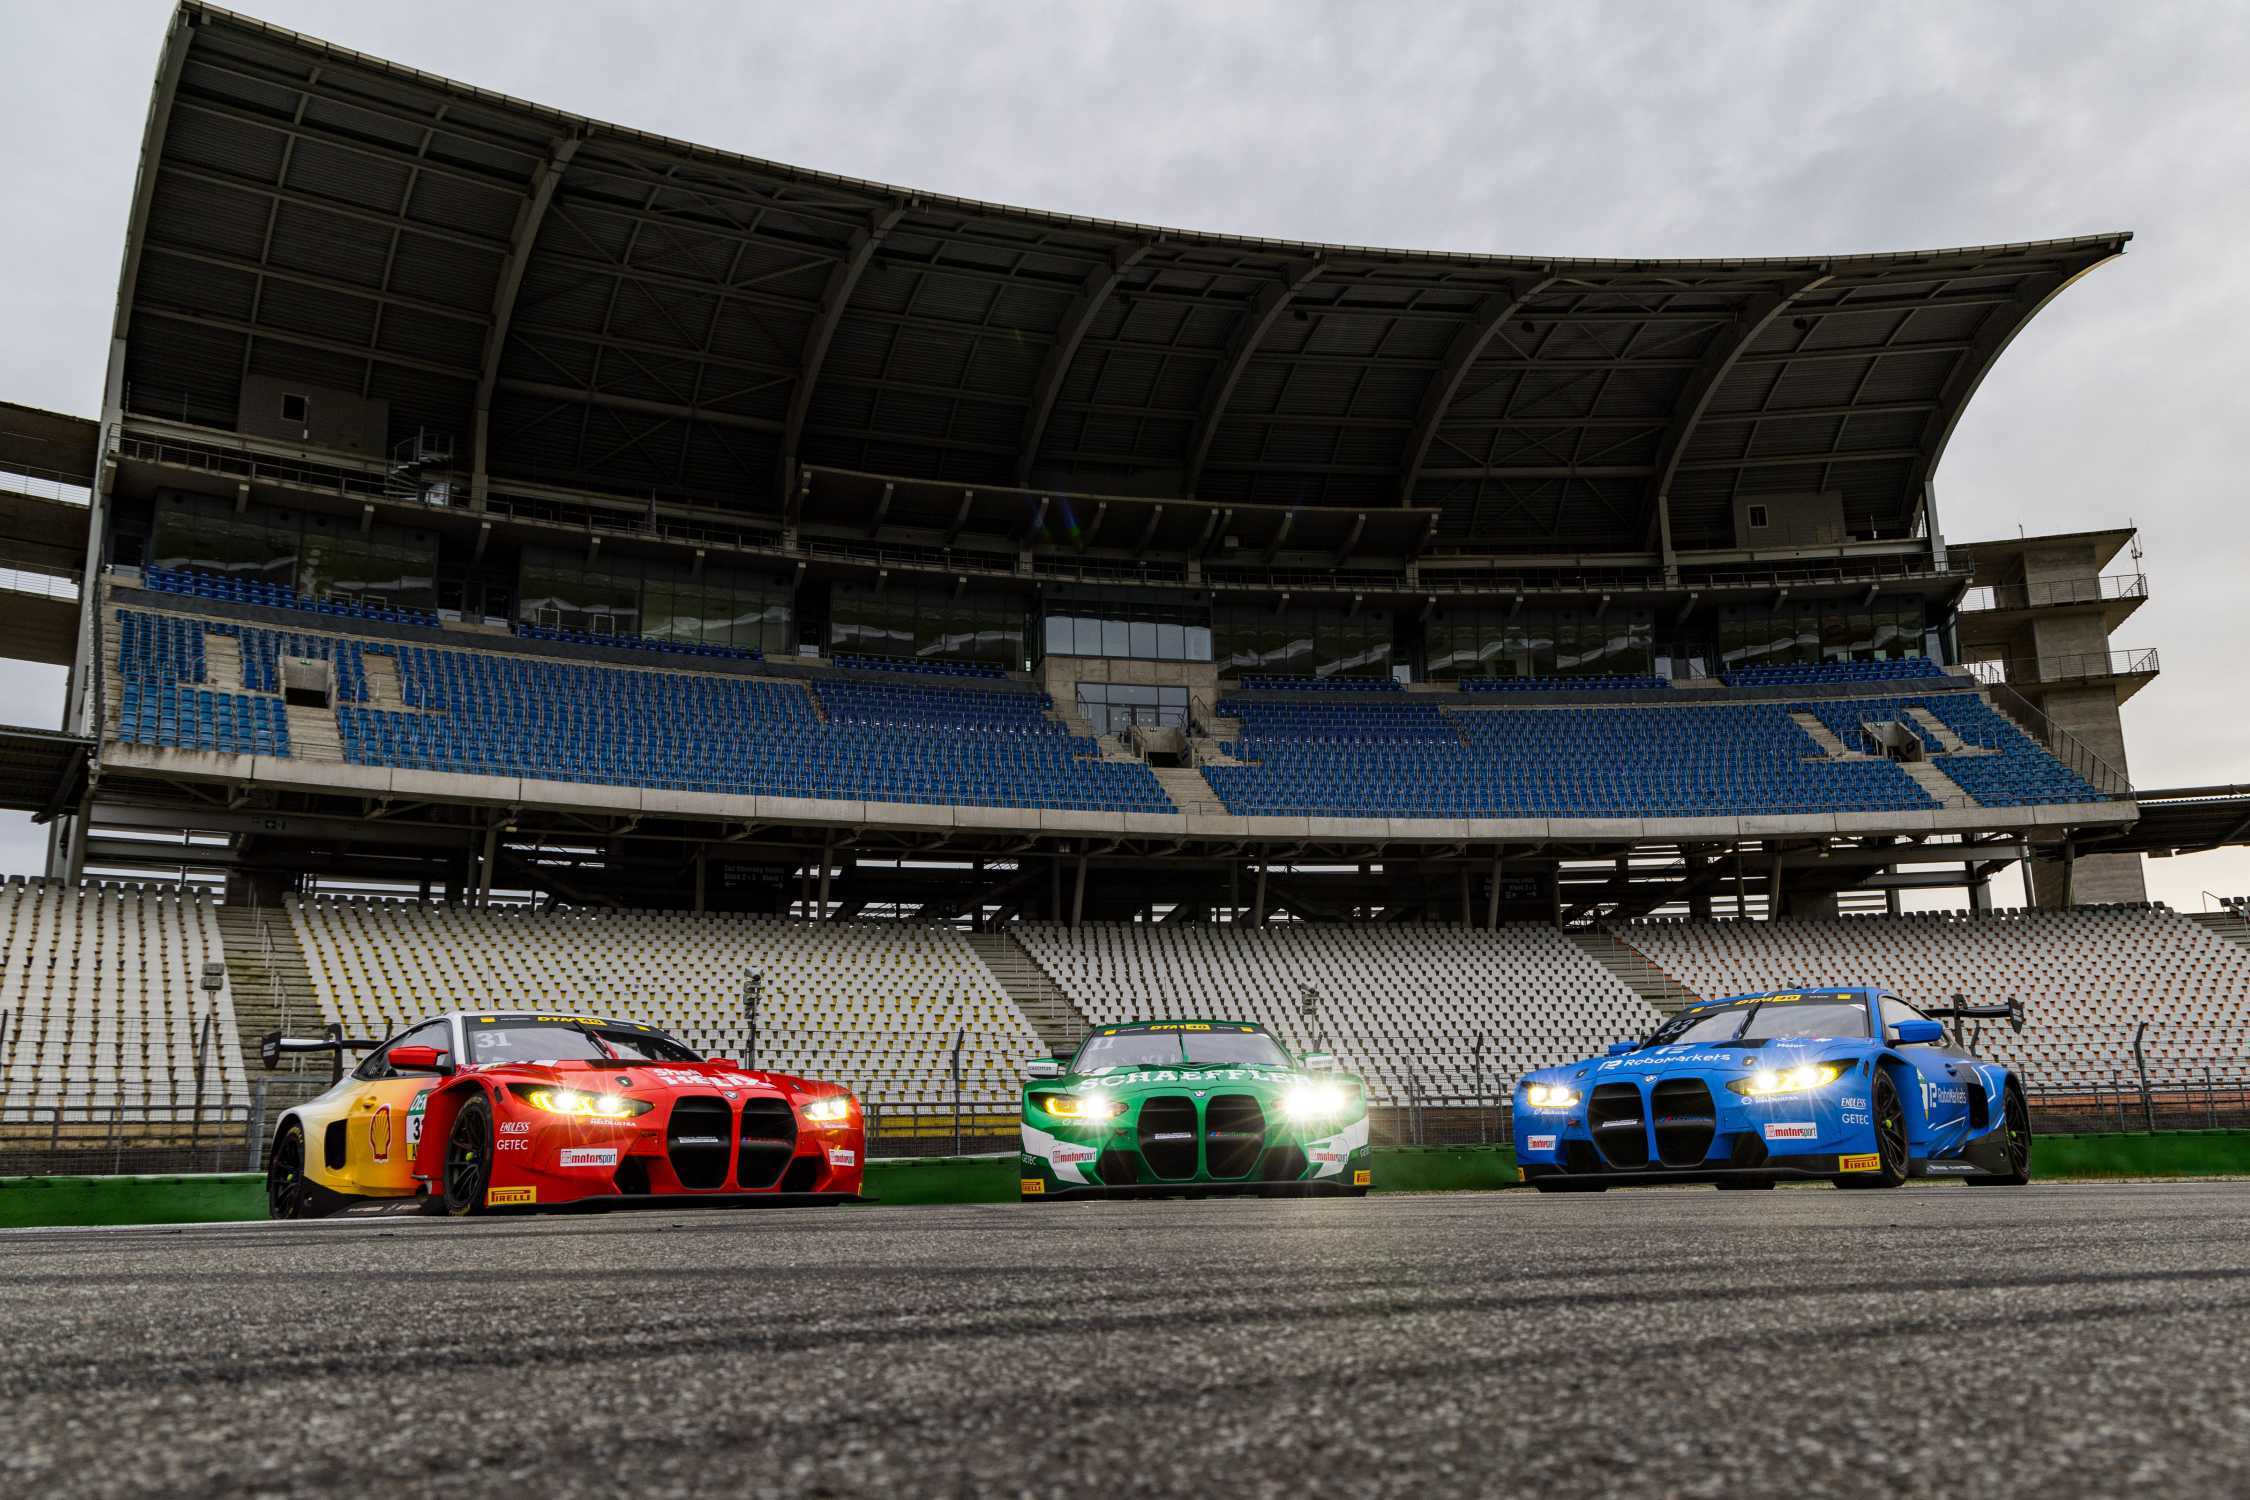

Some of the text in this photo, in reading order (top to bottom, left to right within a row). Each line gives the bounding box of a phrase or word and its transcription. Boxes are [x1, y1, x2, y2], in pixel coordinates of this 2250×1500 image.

[1659, 1018, 1696, 1036] 33
[475, 1031, 512, 1048] 31
[1624, 1053, 1731, 1067] RoboMarkets
[1078, 1069, 1313, 1091] SCHAEFFLER
[1841, 1098, 1866, 1108] ENDLESS
[1842, 1114, 1869, 1124] GETEC
[500, 1121, 529, 1133] ENDLESS
[1775, 1127, 1816, 1138] motorsport
[496, 1139, 529, 1150] GETEC
[571, 1153, 616, 1166] motorsport
[1844, 1156, 1878, 1169] PIRELLI
[491, 1189, 531, 1202] PIRELLI
